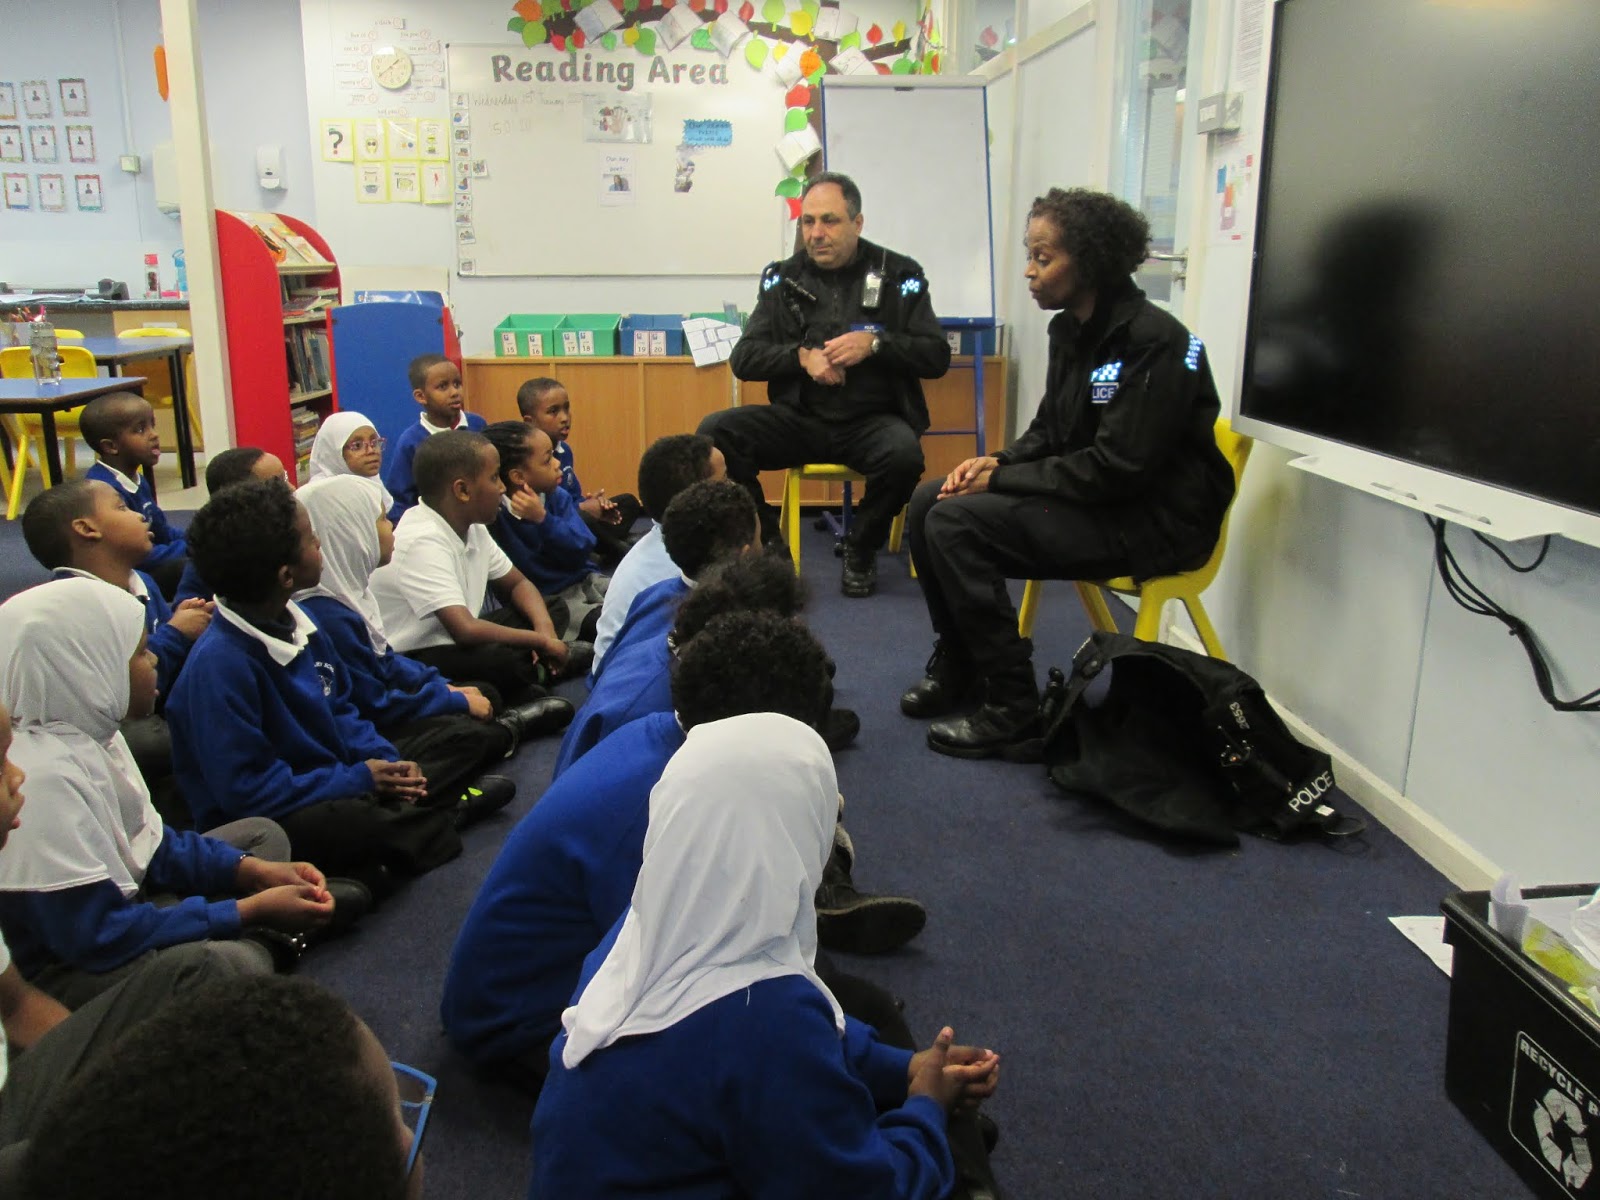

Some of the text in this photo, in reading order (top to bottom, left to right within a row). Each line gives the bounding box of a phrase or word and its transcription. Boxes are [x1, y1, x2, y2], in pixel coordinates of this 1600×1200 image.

[492, 53, 729, 91] Reading Area
[1288, 770, 1333, 812] POLICE
[1520, 1037, 1584, 1105] RECYCLE
